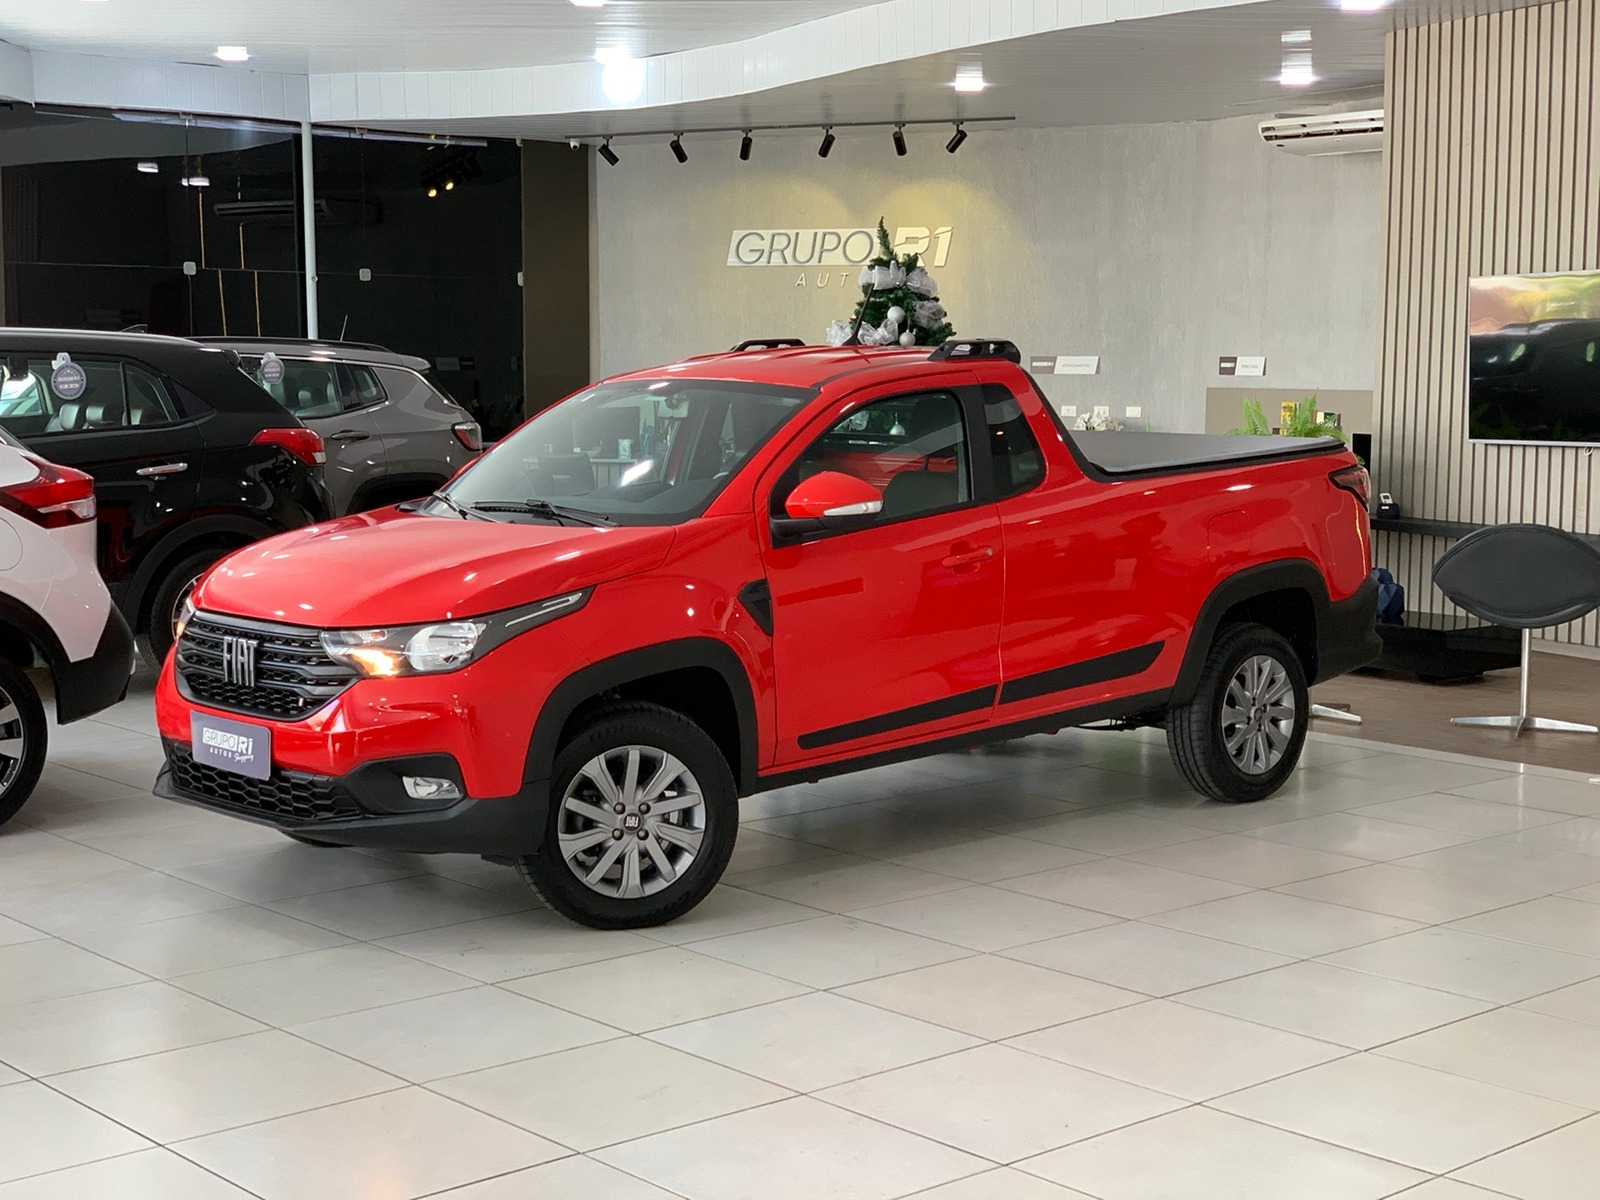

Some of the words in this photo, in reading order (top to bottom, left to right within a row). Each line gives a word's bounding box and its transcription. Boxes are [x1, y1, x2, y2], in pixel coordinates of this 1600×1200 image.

[735, 230, 875, 265] GRUPO
[893, 226, 953, 268] R1
[794, 272, 850, 289] AUT
[222, 635, 260, 688] FIAT
[203, 729, 236, 750] GRUPO
[209, 746, 232, 759] AUTOS
